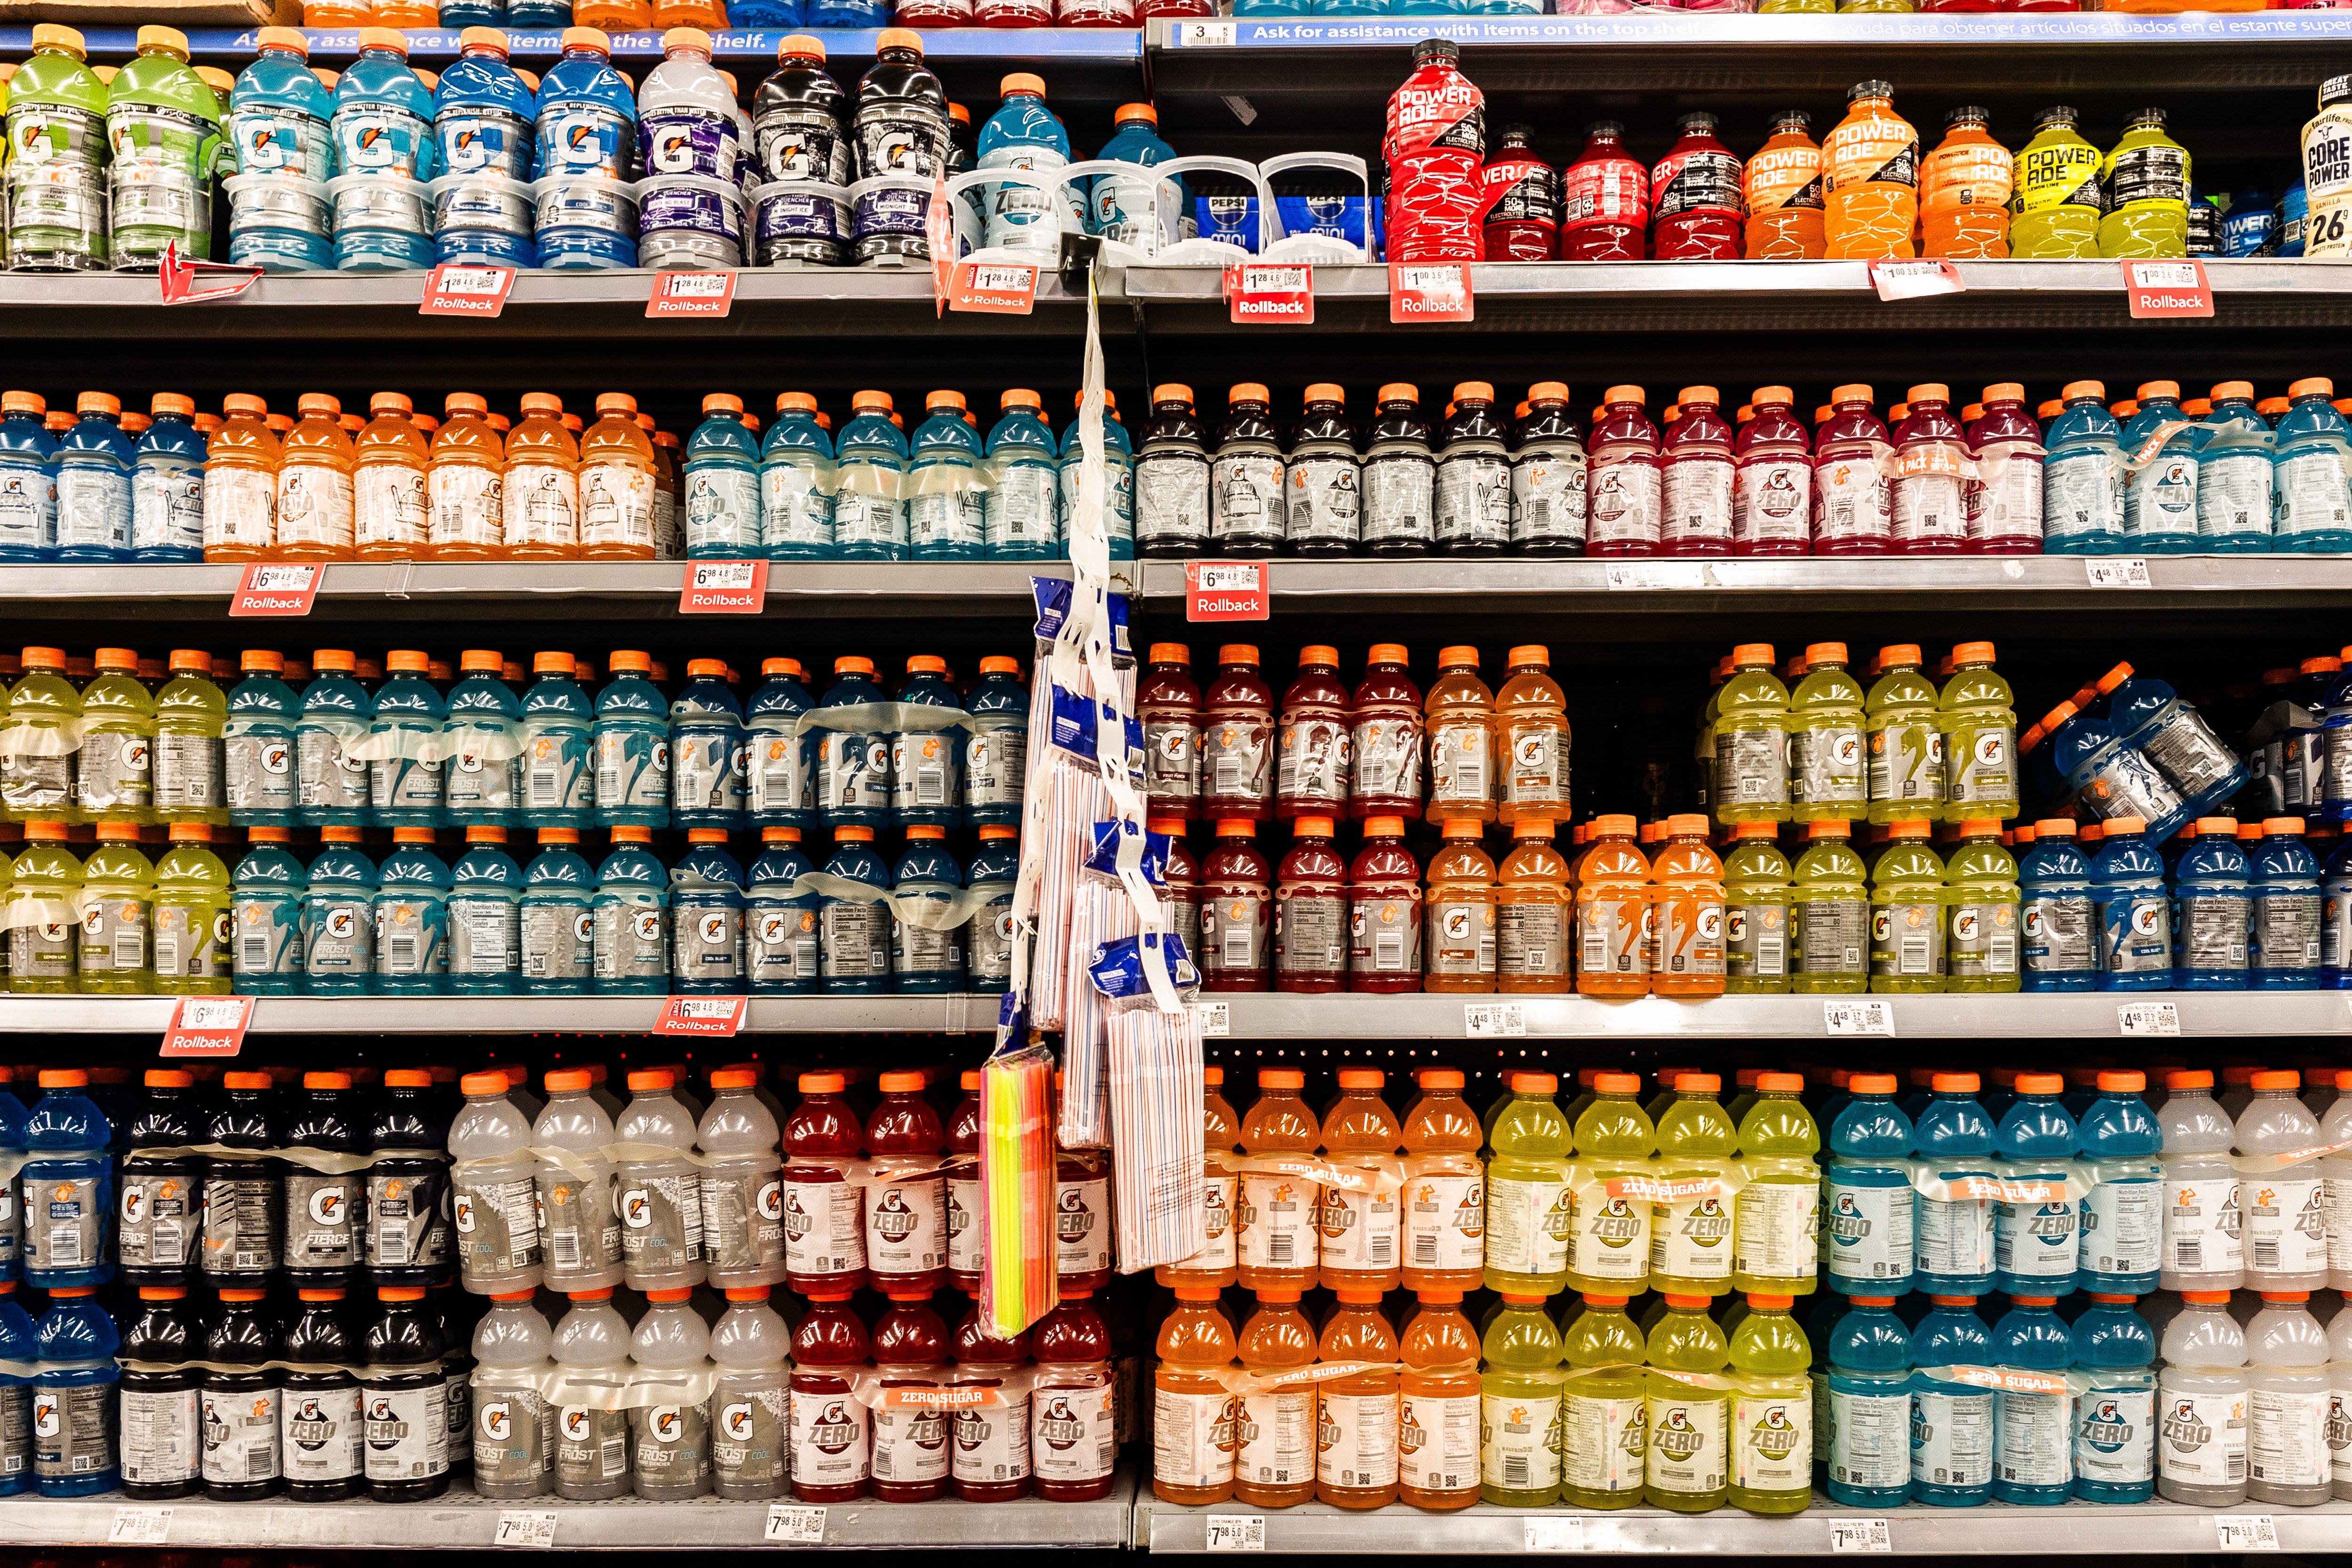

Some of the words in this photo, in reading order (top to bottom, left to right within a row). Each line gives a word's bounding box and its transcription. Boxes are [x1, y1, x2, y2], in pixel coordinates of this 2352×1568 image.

[1196, 27, 1205, 37] 3
[1254, 26, 1290, 38] Ask
[1294, 25, 1323, 38] for
[1327, 25, 1430, 37] assistance
[1437, 24, 1478, 36] with
[1484, 24, 1539, 36] items
[1544, 25, 1570, 36] on
[1574, 24, 1608, 35] the
[1613, 24, 1647, 37] top
[1840, 23, 1895, 37] ayuda
[1899, 24, 1938, 37] para
[1944, 22, 2015, 34] obtener
[2020, 21, 2097, 33] artículos
[2101, 21, 2176, 33] situados
[2181, 22, 2204, 32] en
[2209, 20, 2225, 32] el
[2229, 20, 2297, 32] estante
[2301, 21, 2352, 33] super
[233, 33, 258, 46] As
[320, 36, 441, 47] assnce
[513, 34, 563, 47] item
[613, 34, 652, 48] the
[2323, 75, 2349, 87] GREAT
[2323, 83, 2348, 94] TASTE
[1399, 87, 1471, 110] POWER
[1399, 103, 1438, 125] ADE
[245, 119, 284, 168] G
[346, 116, 394, 167] G
[557, 114, 602, 165] G
[1446, 137, 1478, 147] ELECTROLYTES
[1836, 125, 1906, 147] POWER
[653, 126, 692, 173] G
[769, 133, 808, 181] G
[1836, 142, 1874, 164] ADE
[2308, 137, 2350, 170] CORE
[1752, 152, 1819, 175] POWER
[2027, 149, 2095, 168] POWER
[1881, 171, 1911, 181] ELECTROLYTES
[1896, 166, 1912, 175] MORE
[2028, 165, 2067, 184] ADE
[1751, 169, 1788, 191] ADE
[1210, 198, 1245, 208] PEPSI
[1663, 199, 1680, 208] MORE
[2315, 197, 2341, 210] VANILLA
[2326, 243, 2345, 252] PROTEIN
[433, 297, 493, 310] Rollback
[658, 302, 720, 311] Rollback
[975, 296, 1025, 306] Rollback
[1240, 301, 1303, 313] Rollback
[1402, 299, 1463, 312] Rollback
[2141, 295, 2203, 308] Rollback
[2141, 439, 2161, 460] PACK
[1899, 459, 1904, 473] 6
[1907, 457, 1927, 472] PACK
[2168, 465, 2185, 484] G
[1757, 491, 1802, 507] ZERO
[2152, 486, 2196, 502] ZERO
[242, 597, 302, 608] Rollback
[692, 595, 754, 605] Rollback
[1198, 599, 1259, 610] Rollback
[1159, 730, 1187, 760] G
[1515, 735, 1543, 766] G
[1974, 734, 2003, 765] G
[261, 744, 288, 774] G
[407, 778, 441, 787] FROST
[699, 913, 726, 942] G
[2131, 905, 2158, 936] G
[317, 945, 352, 954] FROST
[666, 1021, 727, 1030] Rollback
[173, 1036, 231, 1048] Rollback
[1279, 1163, 1314, 1175] ZERO
[1317, 1169, 1362, 1186] SUGAR
[1622, 1182, 1653, 1195] ZERO
[1659, 1182, 1705, 1195] SUGAR
[1968, 1183, 2001, 1196] ZERO
[2004, 1185, 2050, 1198] SUGAR
[309, 1186, 346, 1226] G
[1837, 1194, 1855, 1215] G
[873, 1213, 918, 1230] ZERO
[1589, 1218, 1642, 1236] ZERO
[1830, 1218, 1871, 1236] ZERO
[306, 1234, 350, 1245] FIERCE
[475, 1243, 493, 1252] COOL
[497, 1257, 509, 1266] 140
[1274, 1370, 1308, 1383] ZERO
[1312, 1365, 1359, 1378] SUGAR
[1968, 1370, 2002, 1384] ZERO
[2005, 1375, 2051, 1390] SUGAR
[901, 1392, 935, 1403] ZERO
[938, 1392, 983, 1403] SUGAR
[722, 1402, 753, 1441] G
[823, 1402, 844, 1424] G
[288, 1422, 337, 1440] ZERO
[559, 1404, 590, 1441] G
[808, 1425, 860, 1443] ZERO
[2080, 1425, 2133, 1443] ZERO
[2163, 1424, 2212, 1443] ZERO
[1653, 1434, 1704, 1453] ZERO
[509, 1449, 528, 1459] COOL
[638, 1449, 675, 1460] FROST
[680, 1449, 697, 1460] COOL
[714, 1447, 749, 1458] FROST
